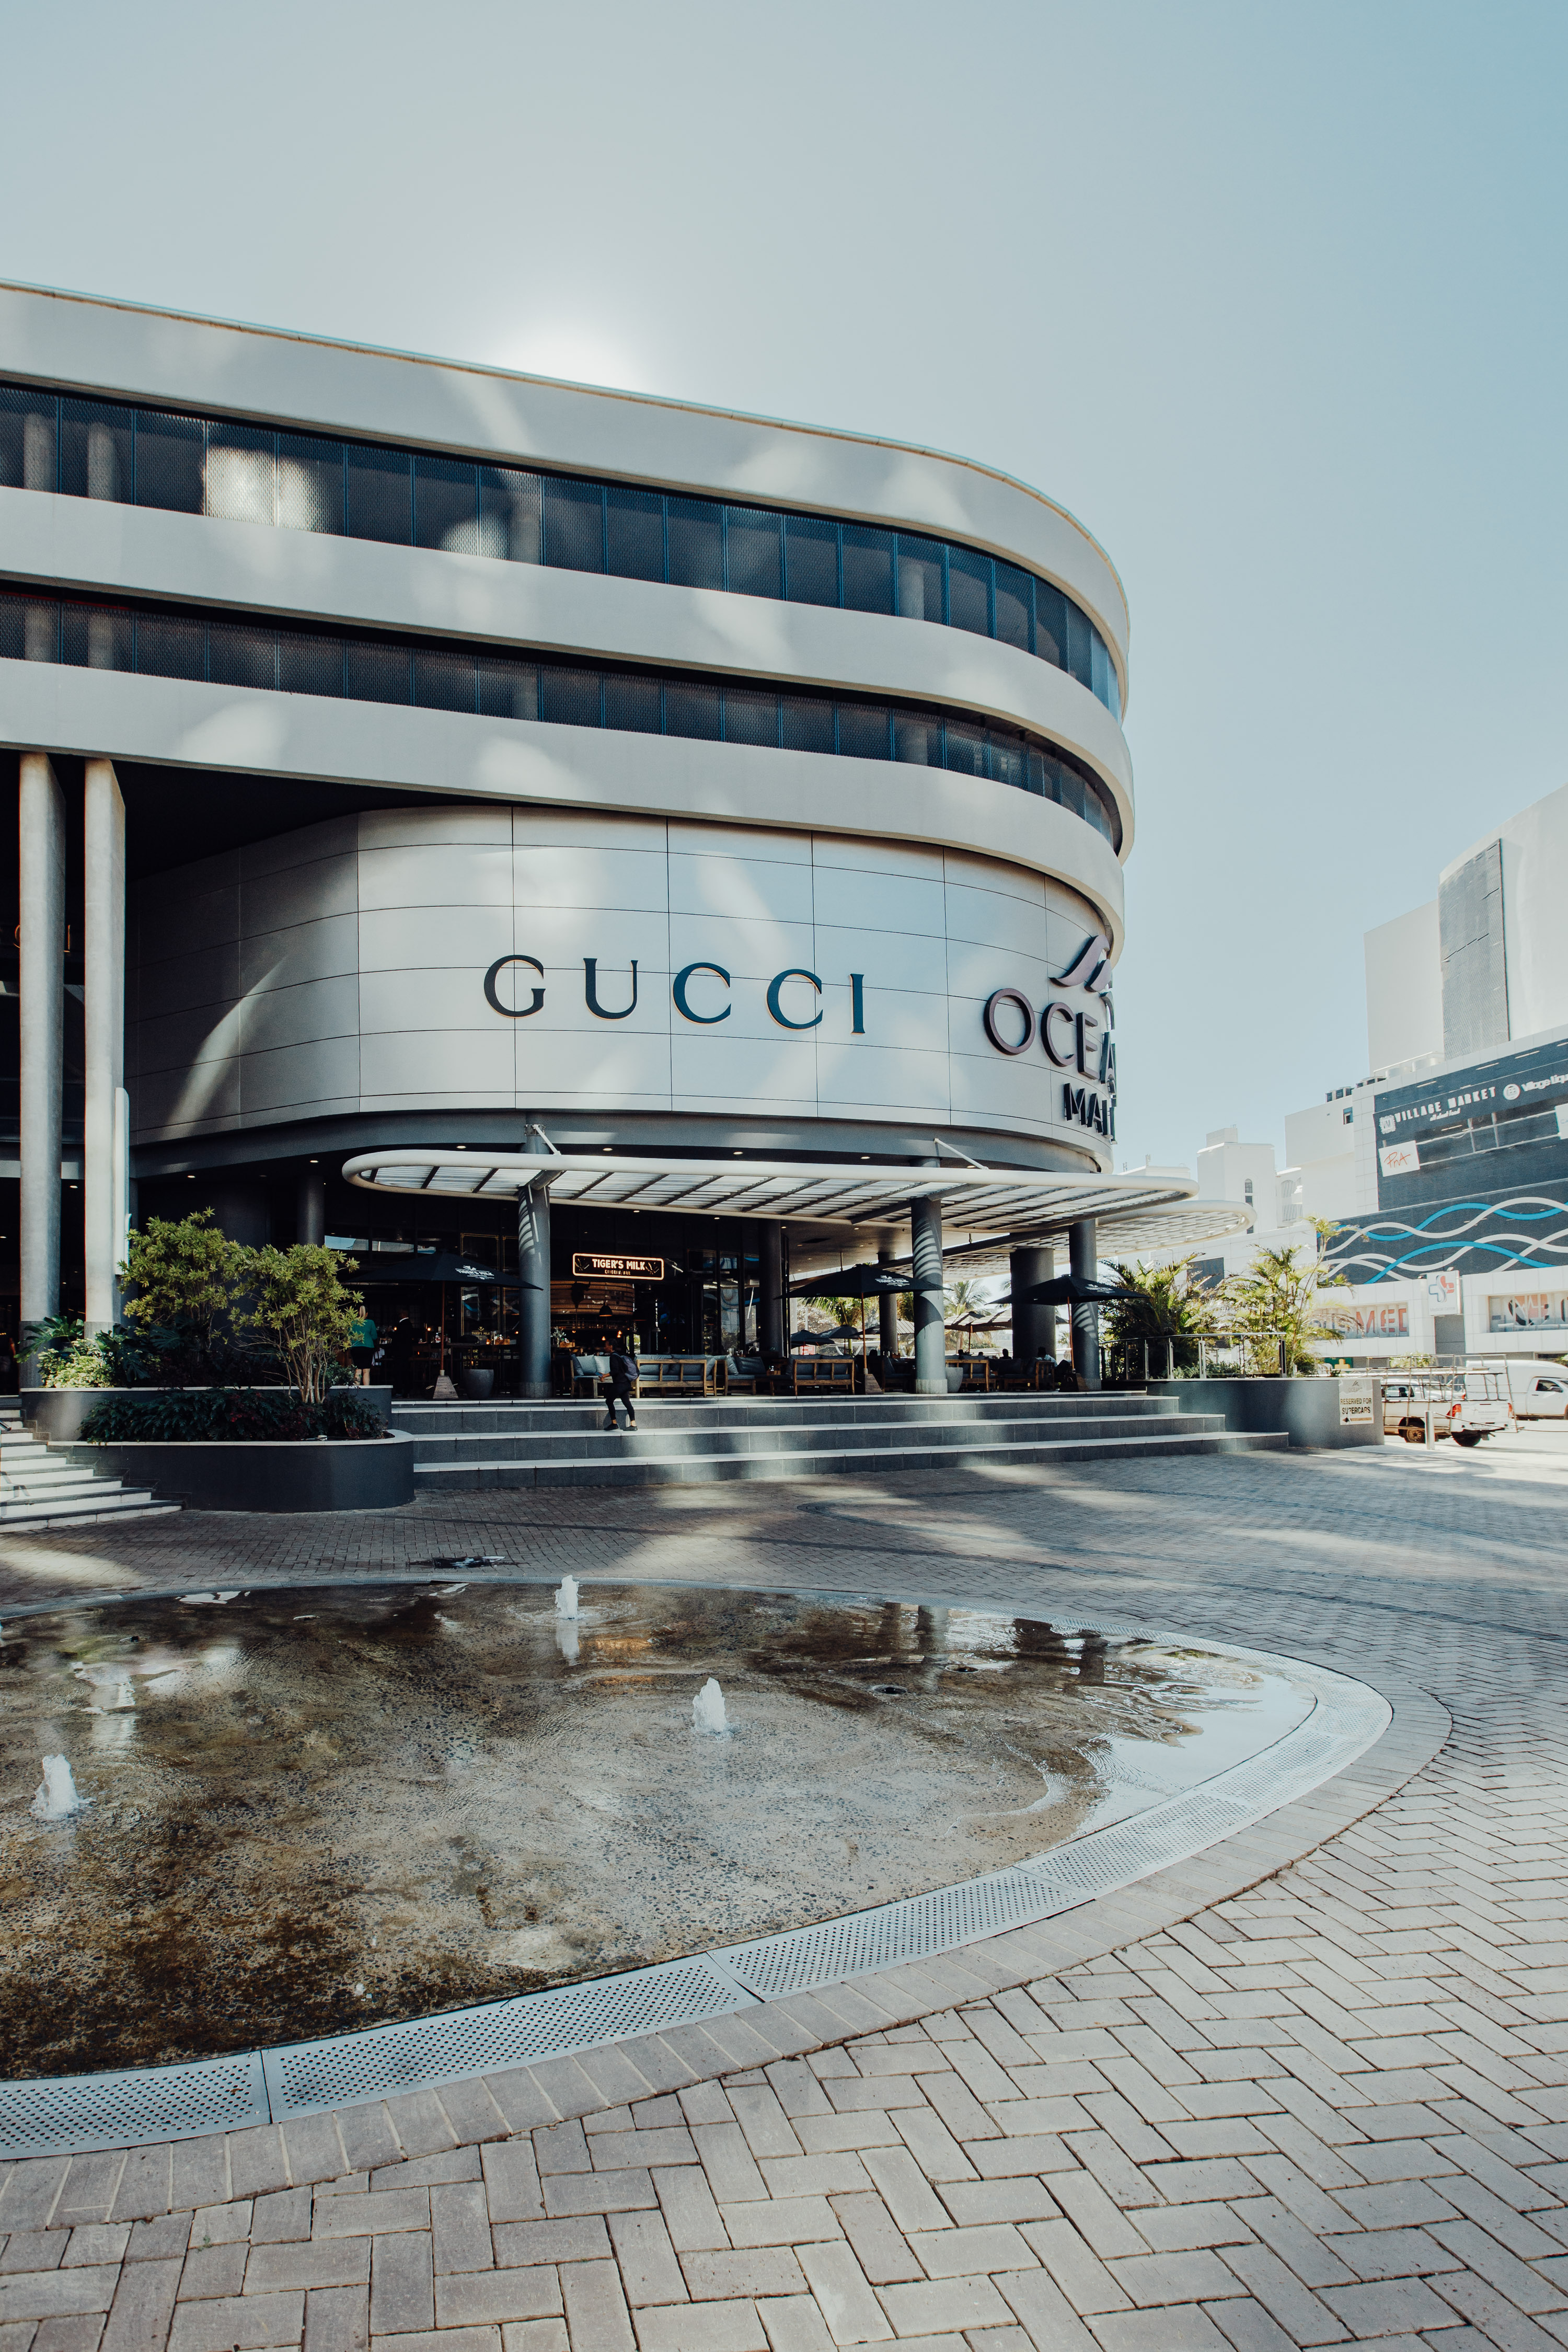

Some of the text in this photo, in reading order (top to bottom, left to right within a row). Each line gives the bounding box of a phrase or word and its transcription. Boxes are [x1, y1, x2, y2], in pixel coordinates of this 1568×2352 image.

[484, 954, 866, 1034] GUCCI
[983, 988, 1116, 1107] OCEA
[1521, 1079, 1551, 1091] Village
[1394, 1087, 1495, 1123] VILLAGE MARKET
[592, 1259, 645, 1271] TIGER'S MILK
[1342, 1406, 1370, 1414] SUPERCARS
